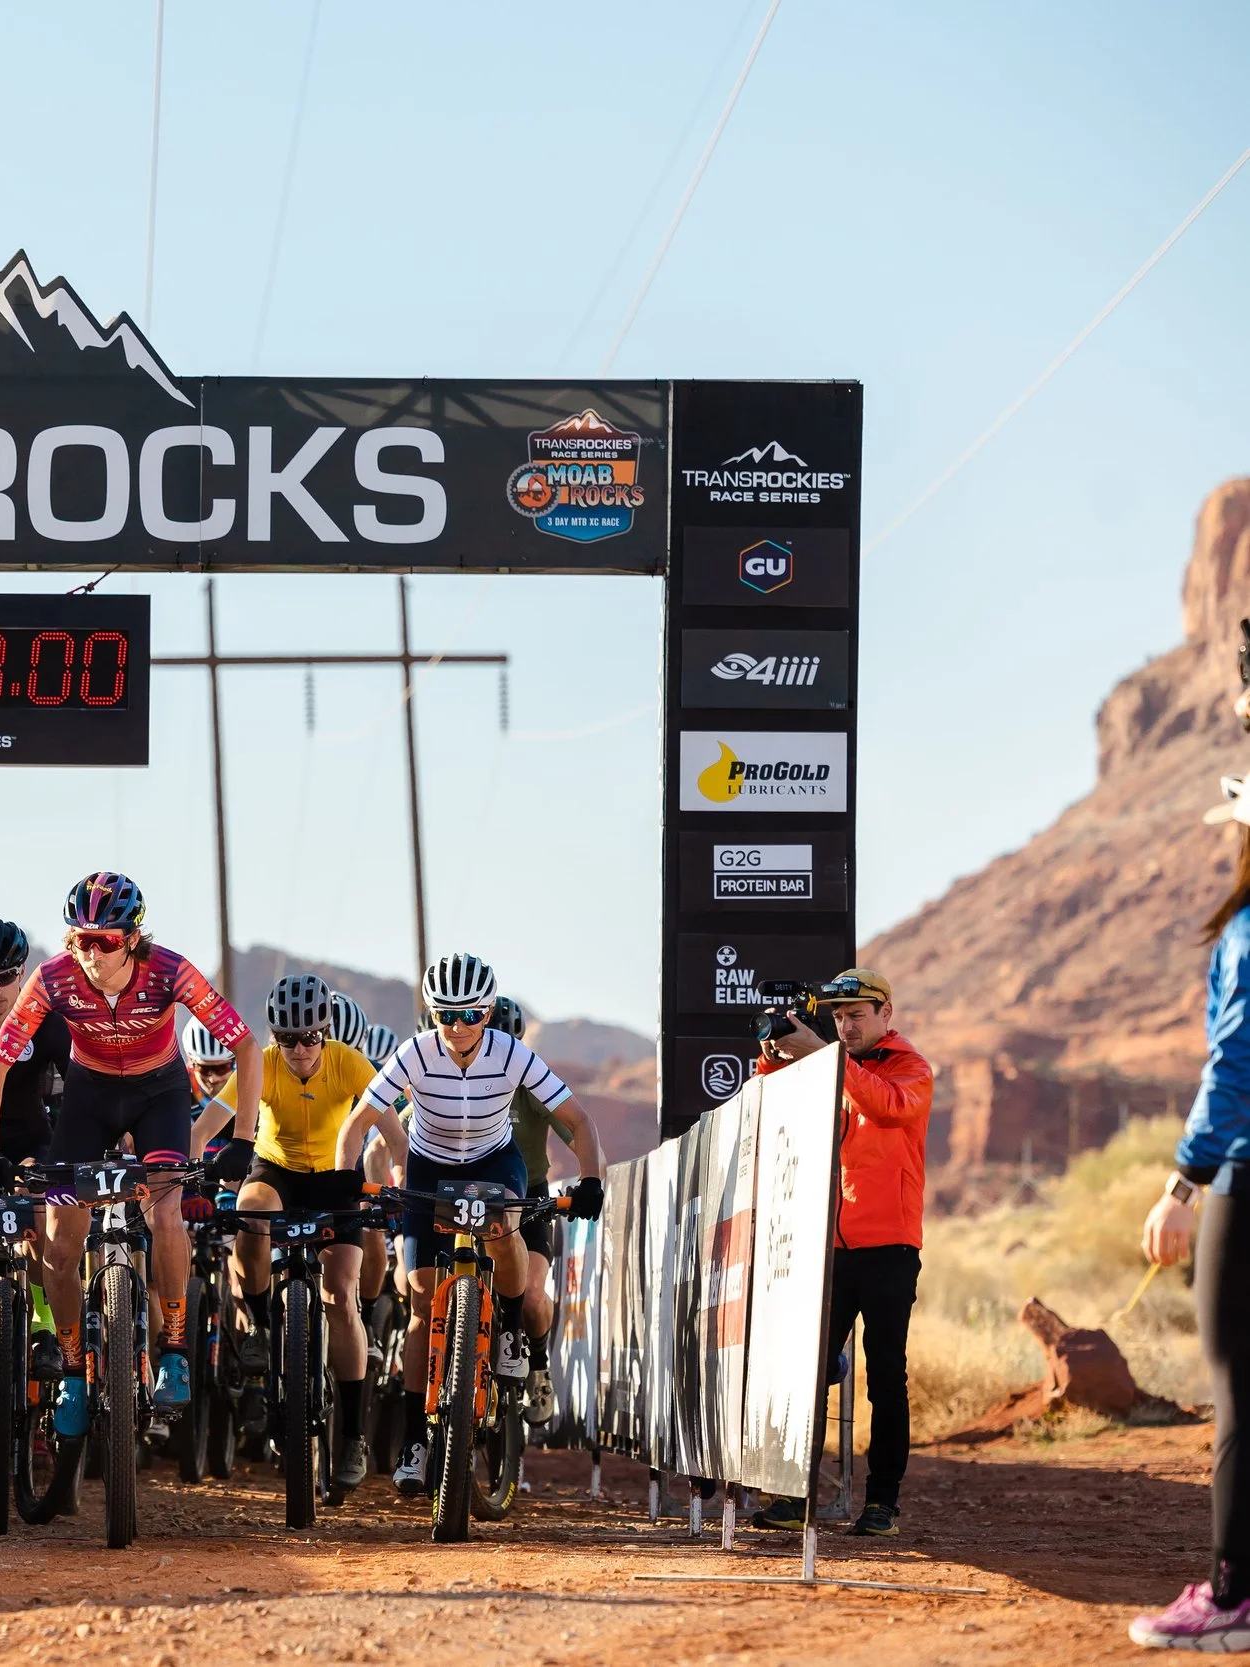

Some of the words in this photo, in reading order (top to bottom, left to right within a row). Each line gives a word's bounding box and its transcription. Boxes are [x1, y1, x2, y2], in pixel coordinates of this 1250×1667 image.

[534, 438, 632, 450] TRANSROCKIES
[551, 451, 578, 459] RACE
[580, 451, 618, 460] SERIES
[547, 465, 613, 486] MOAB
[569, 486, 644, 508] ROCKS
[710, 490, 755, 502] RACE
[759, 491, 821, 504] SERIES
[547, 517, 553, 527] 3
[554, 517, 569, 527] DAY
[571, 517, 587, 527] MTB
[589, 517, 600, 527] XC
[601, 517, 620, 527] RACE
[745, 557, 787, 577] GU
[727, 784, 827, 796] LUBRICANTS
[719, 850, 761, 867] G2G
[720, 879, 777, 892] PROTEIN
[779, 879, 805, 892] BAR
[715, 968, 755, 986] RAW
[774, 983, 794, 992] DEITY
[94, 1168, 128, 1197] 17
[452, 1198, 487, 1227] 39
